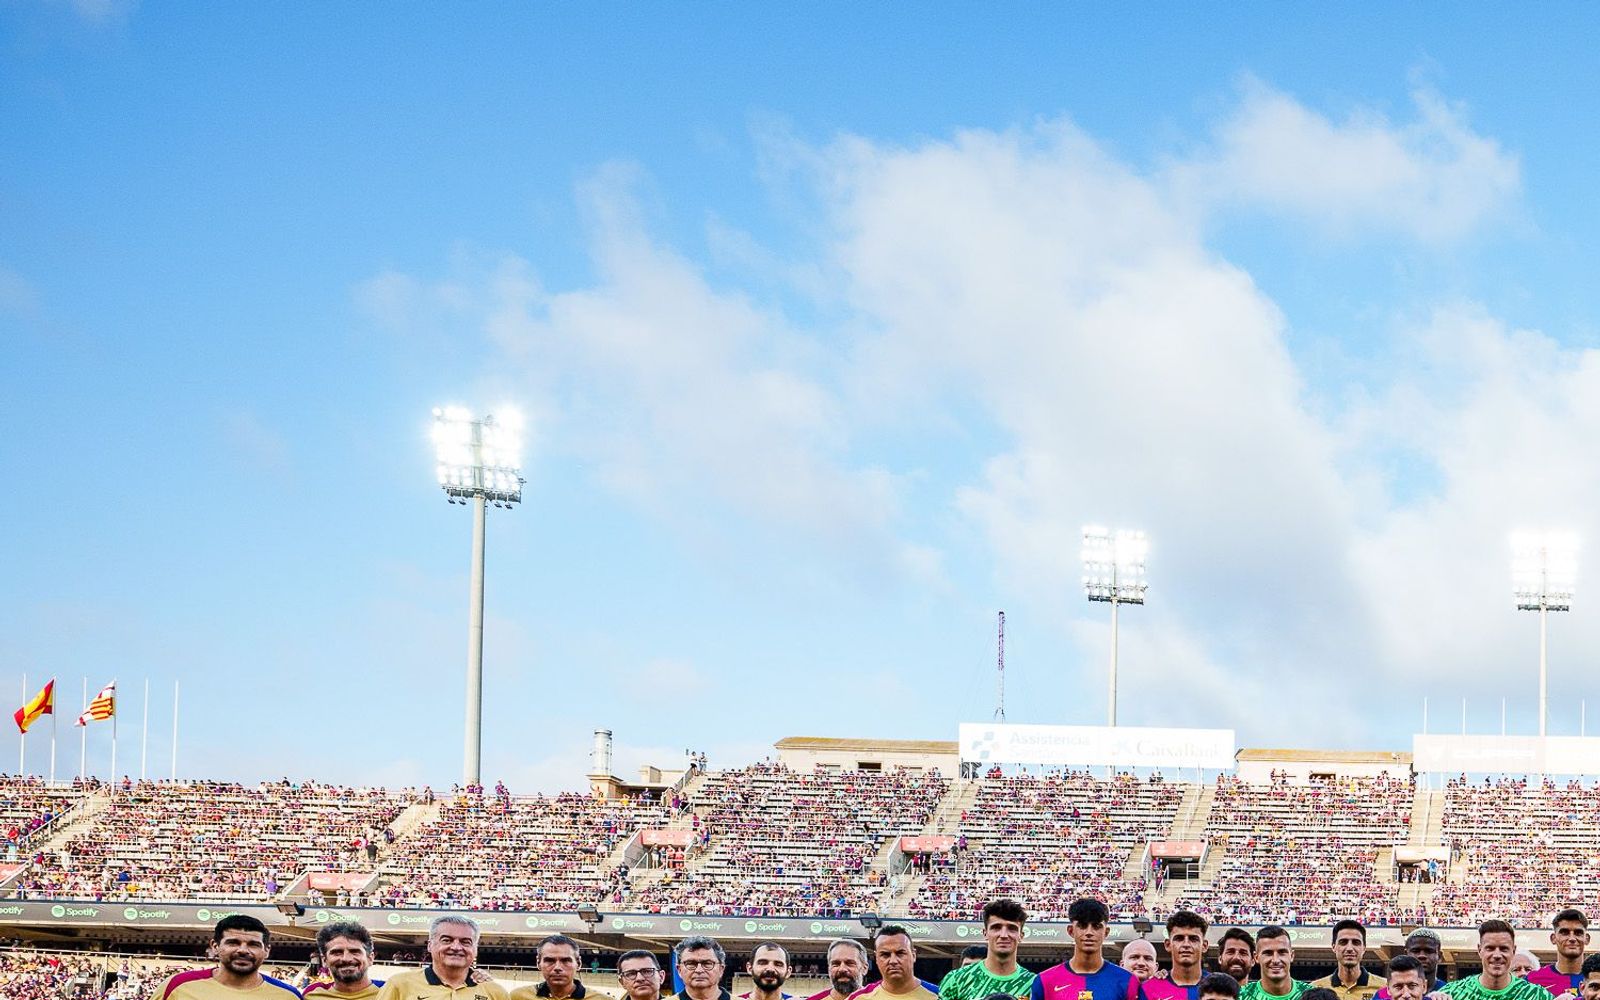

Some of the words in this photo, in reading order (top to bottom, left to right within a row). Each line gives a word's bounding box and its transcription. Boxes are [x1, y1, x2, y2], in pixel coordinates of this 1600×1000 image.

[0, 905, 24, 916] potify
[66, 907, 99, 917] Spotify
[139, 910, 171, 920] Spotify
[538, 917, 568, 927] Spotify
[625, 921, 655, 930] Spotify
[691, 921, 722, 931] Spotify
[758, 922, 787, 932] Spotify
[822, 923, 852, 933] Spotify
[1031, 926, 1059, 937] Spotify
[1298, 928, 1326, 939] Spotify
